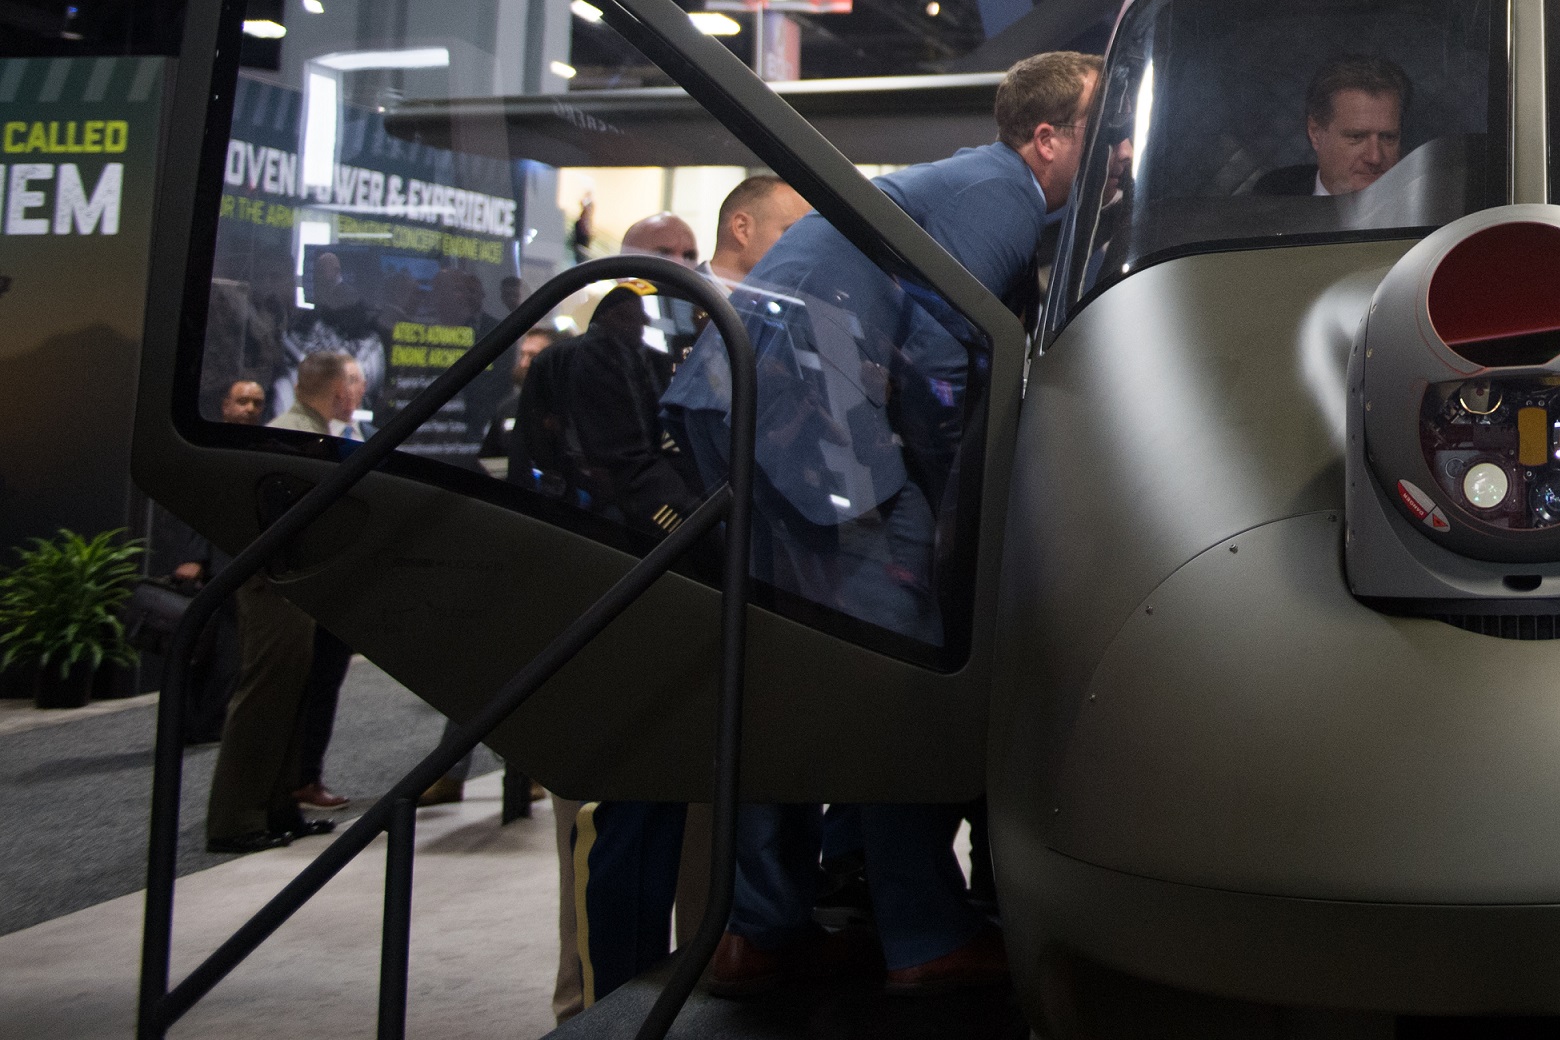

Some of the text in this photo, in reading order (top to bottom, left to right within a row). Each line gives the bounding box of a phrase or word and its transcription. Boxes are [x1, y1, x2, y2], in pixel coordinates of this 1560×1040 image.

[3, 120, 129, 154] CALLED
[0, 163, 124, 236] EM
[406, 177, 517, 238] EXPERIENCE
[1402, 492, 1425, 516] DANGER
